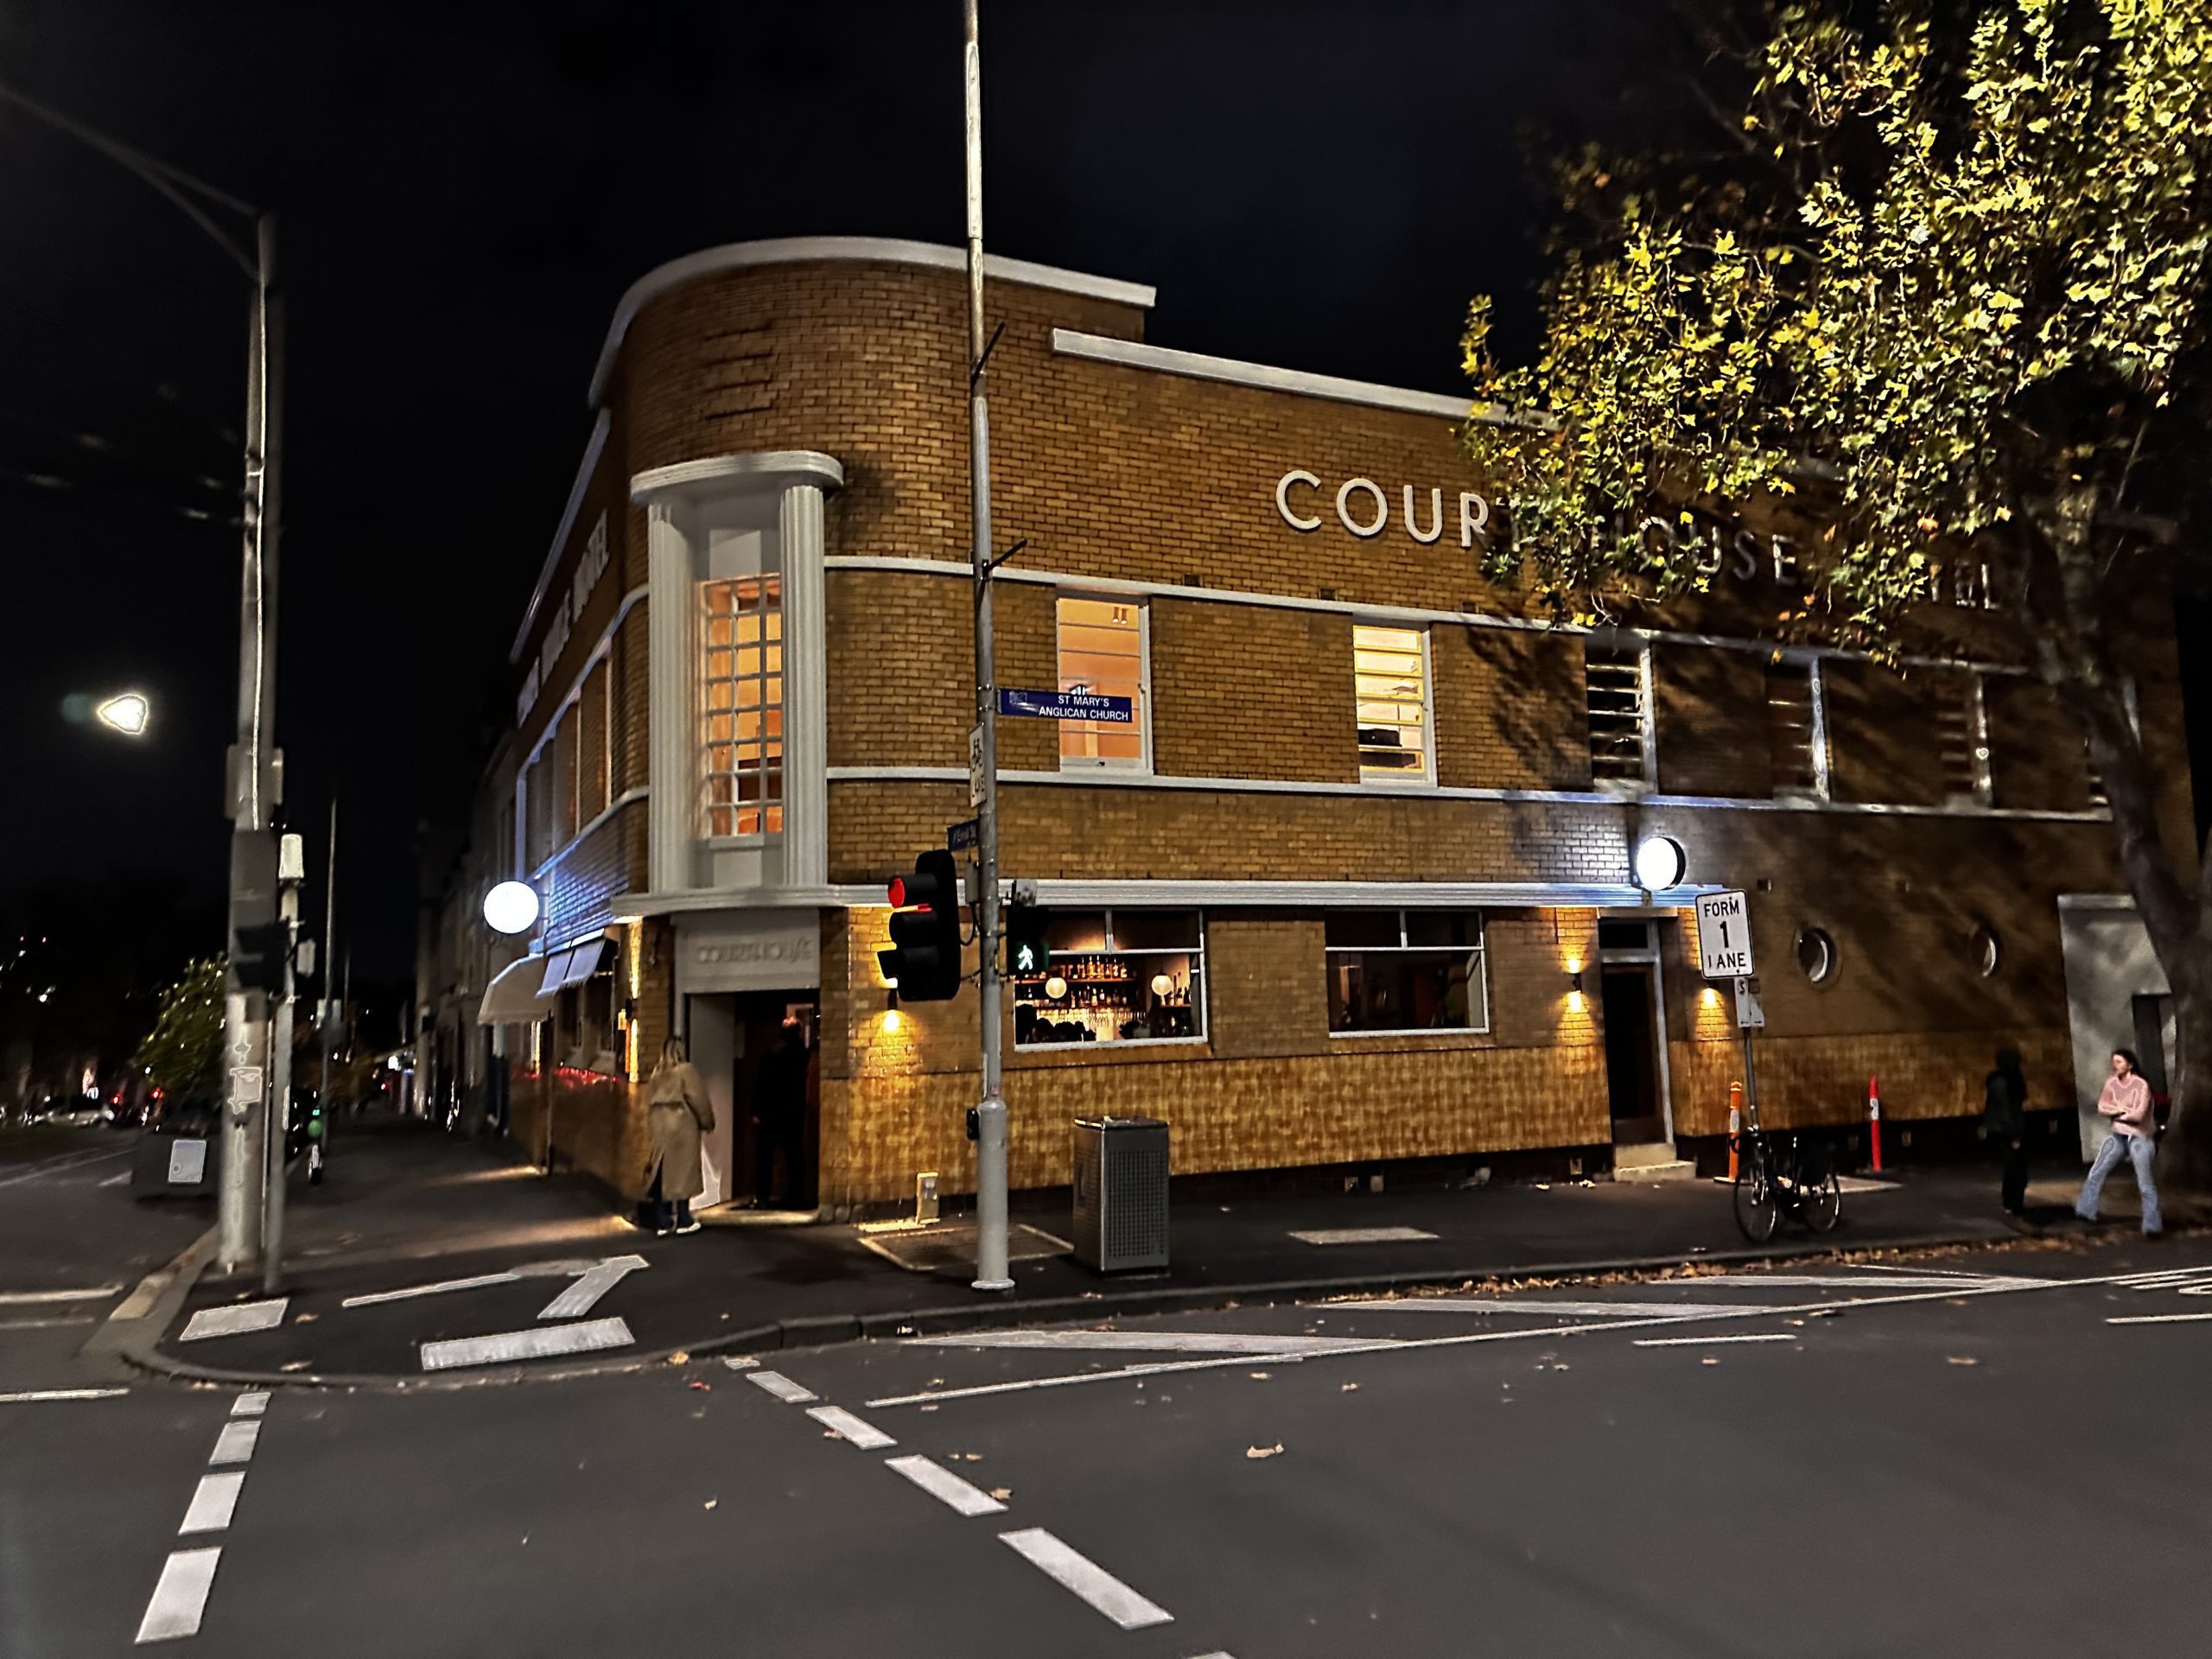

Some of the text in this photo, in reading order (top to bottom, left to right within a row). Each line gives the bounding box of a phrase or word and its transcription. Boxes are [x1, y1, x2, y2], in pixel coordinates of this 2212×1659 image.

[1058, 695, 1109, 708] ST MARY'S
[1039, 706, 1128, 721] ANGLICAN CHURCH
[1704, 899, 1740, 918] FORM
[1719, 920, 1729, 949] 1
[1707, 952, 1746, 969] LANE
